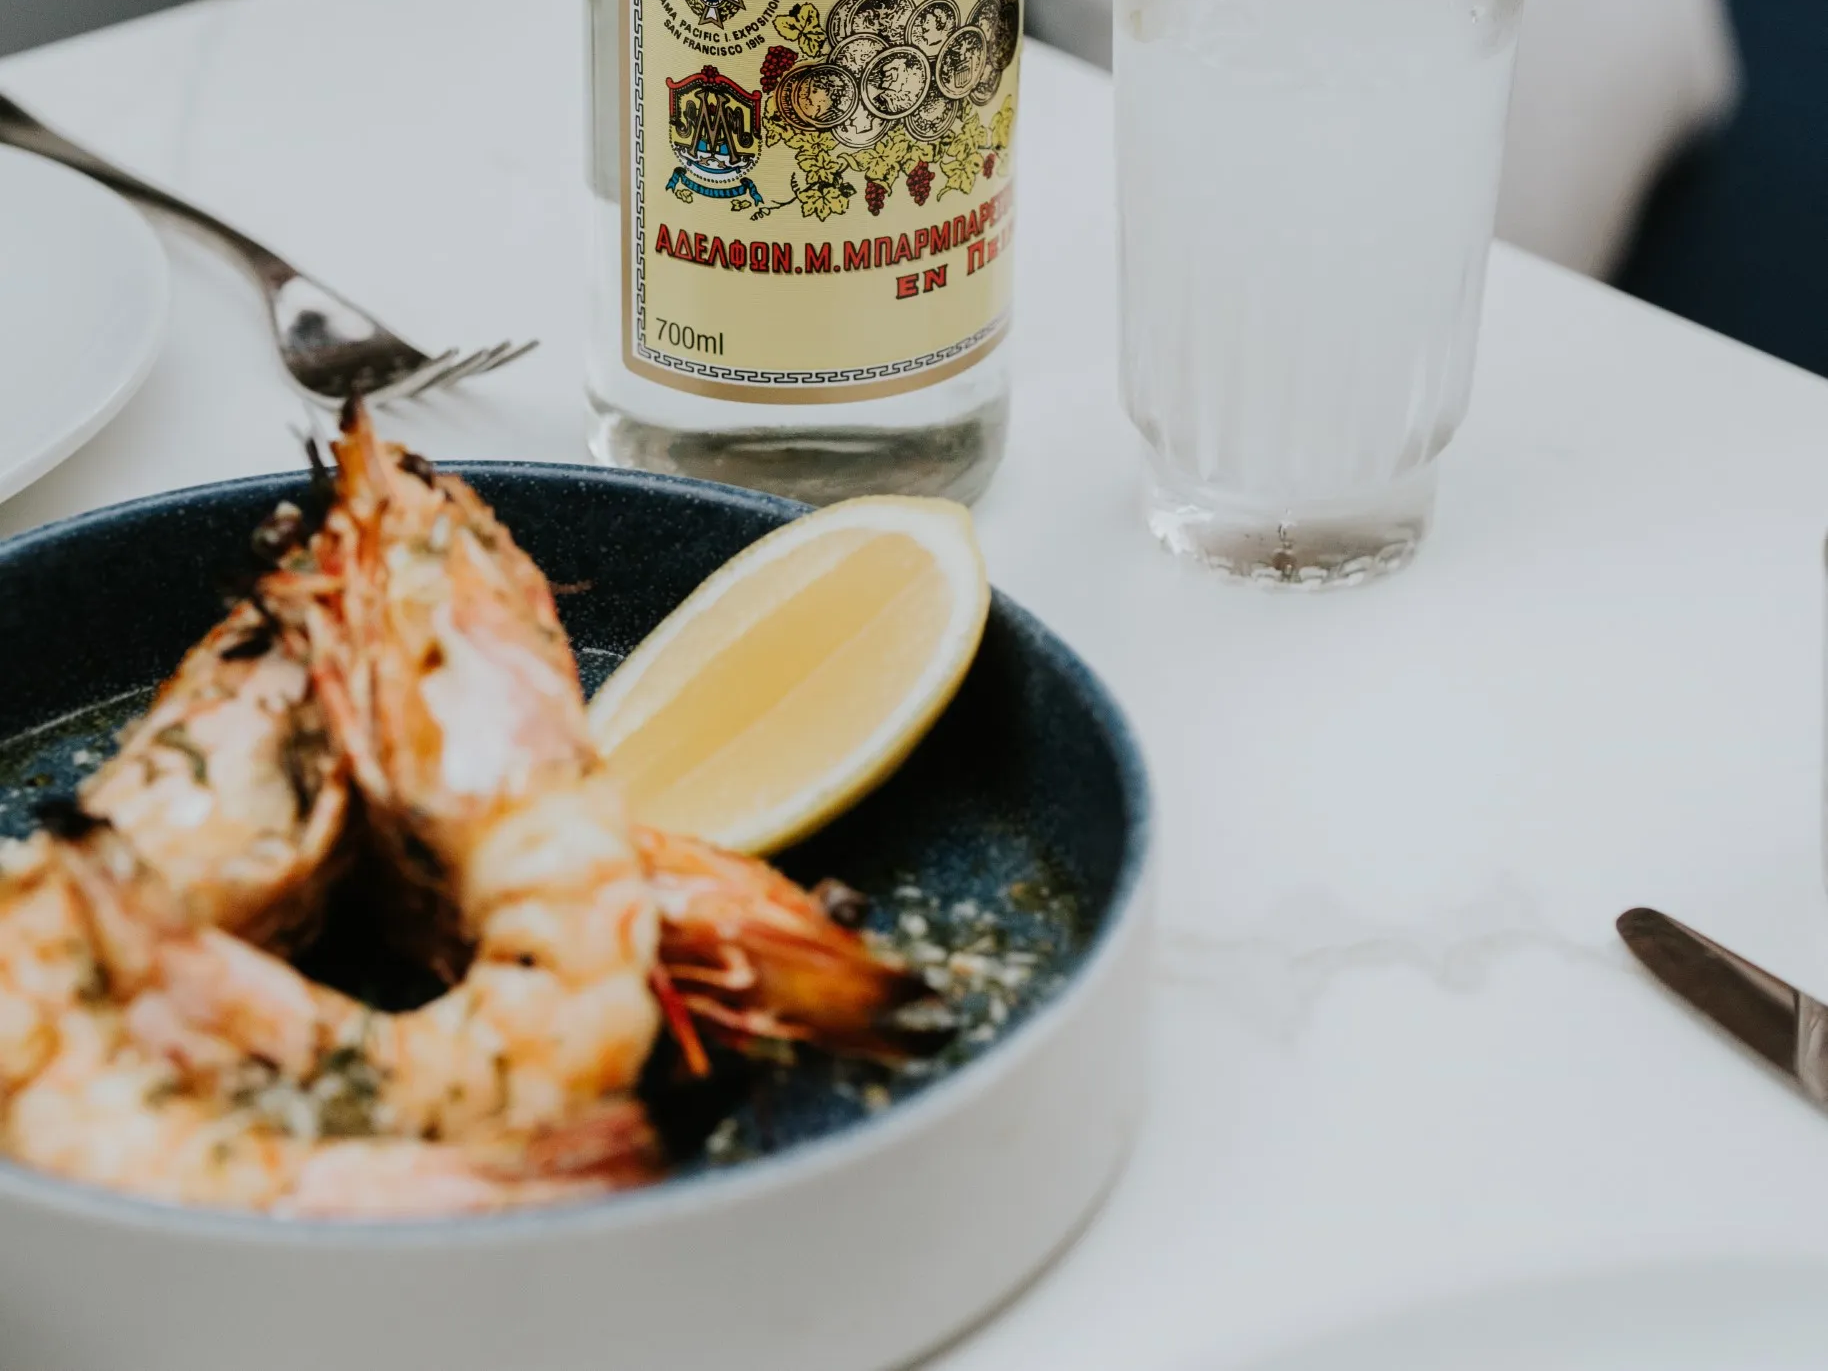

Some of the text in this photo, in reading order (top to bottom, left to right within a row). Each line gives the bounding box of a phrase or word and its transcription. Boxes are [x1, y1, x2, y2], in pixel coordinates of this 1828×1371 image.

[663, 18, 766, 56] SAN FRANCISCO 1915
[679, 18, 721, 43] PACIFIC
[655, 317, 724, 356] 700ml
